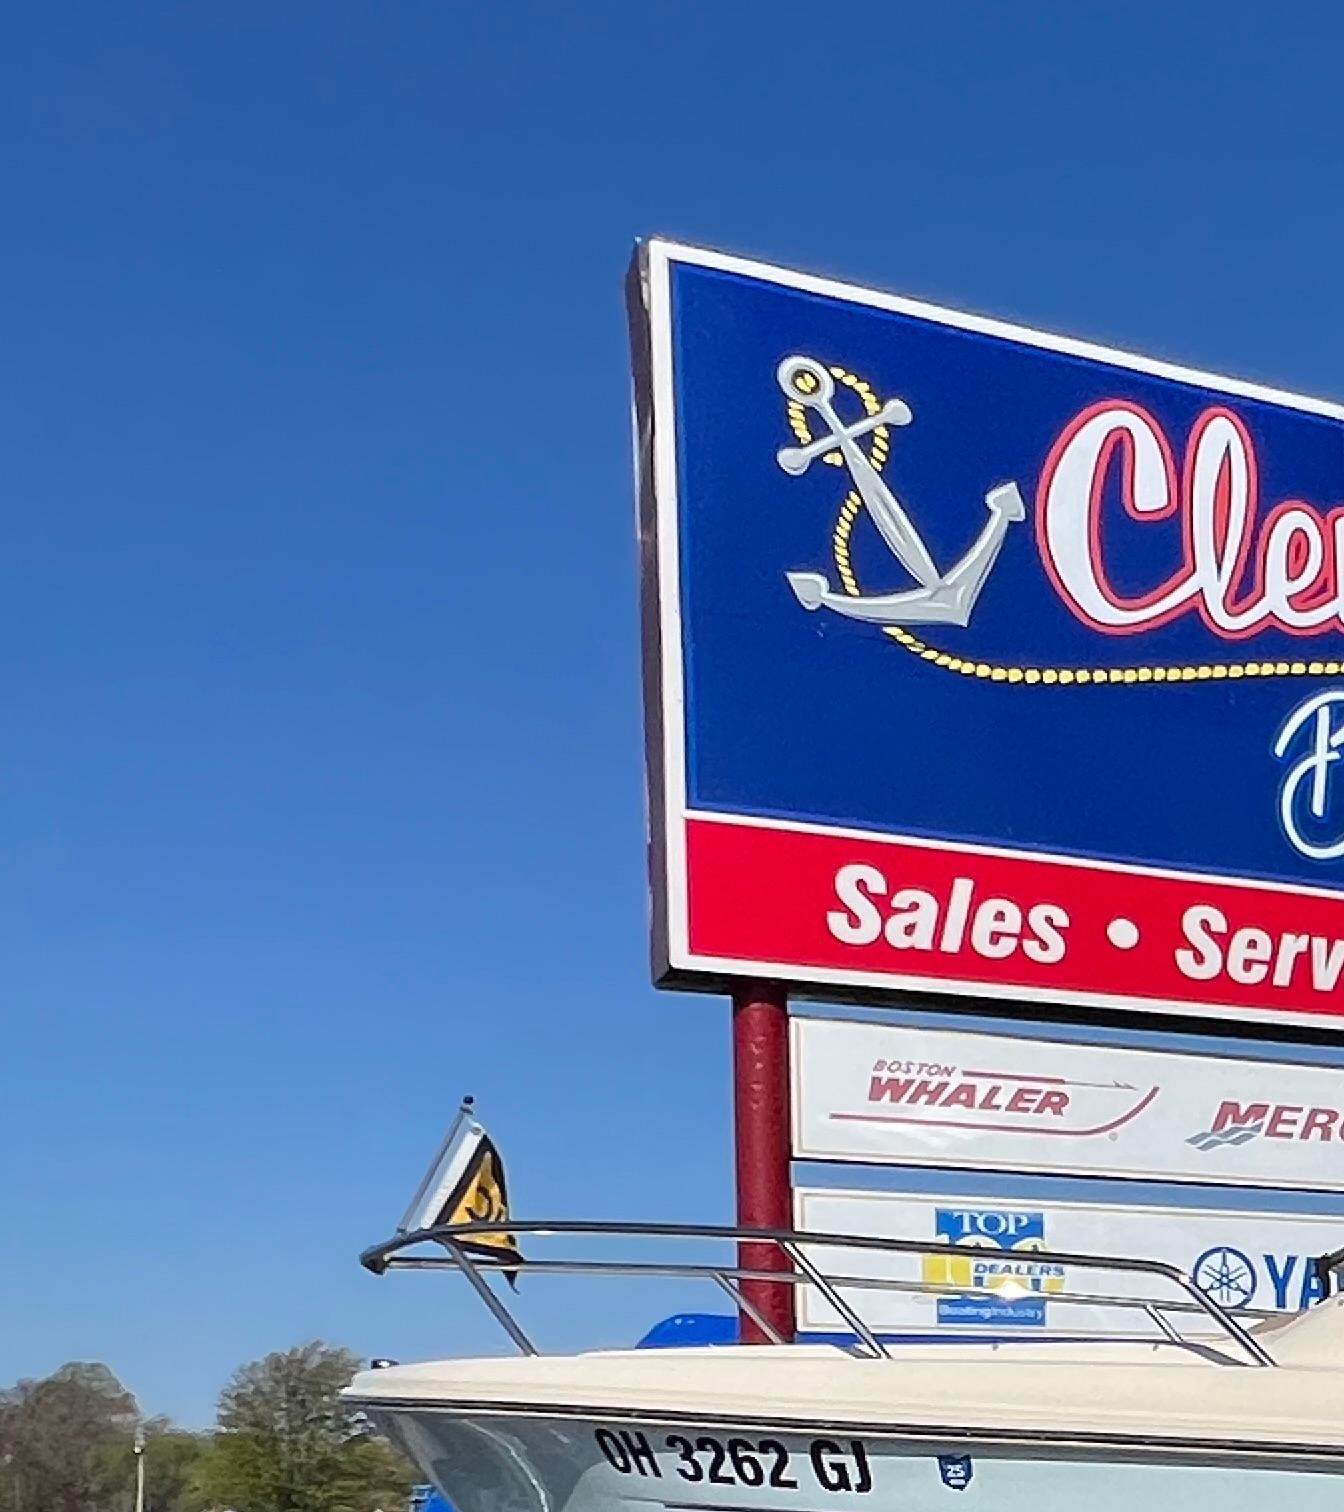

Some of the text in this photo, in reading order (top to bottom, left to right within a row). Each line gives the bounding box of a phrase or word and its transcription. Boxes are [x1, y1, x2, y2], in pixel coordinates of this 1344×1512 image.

[826, 863, 1071, 964] Sales
[872, 1059, 957, 1077] BOSTON
[868, 1076, 1070, 1116] WHALER
[952, 1211, 1029, 1236] TOP
[974, 1262, 1065, 1276] DEALERS
[595, 1428, 872, 1493] OH 3262 GJ
